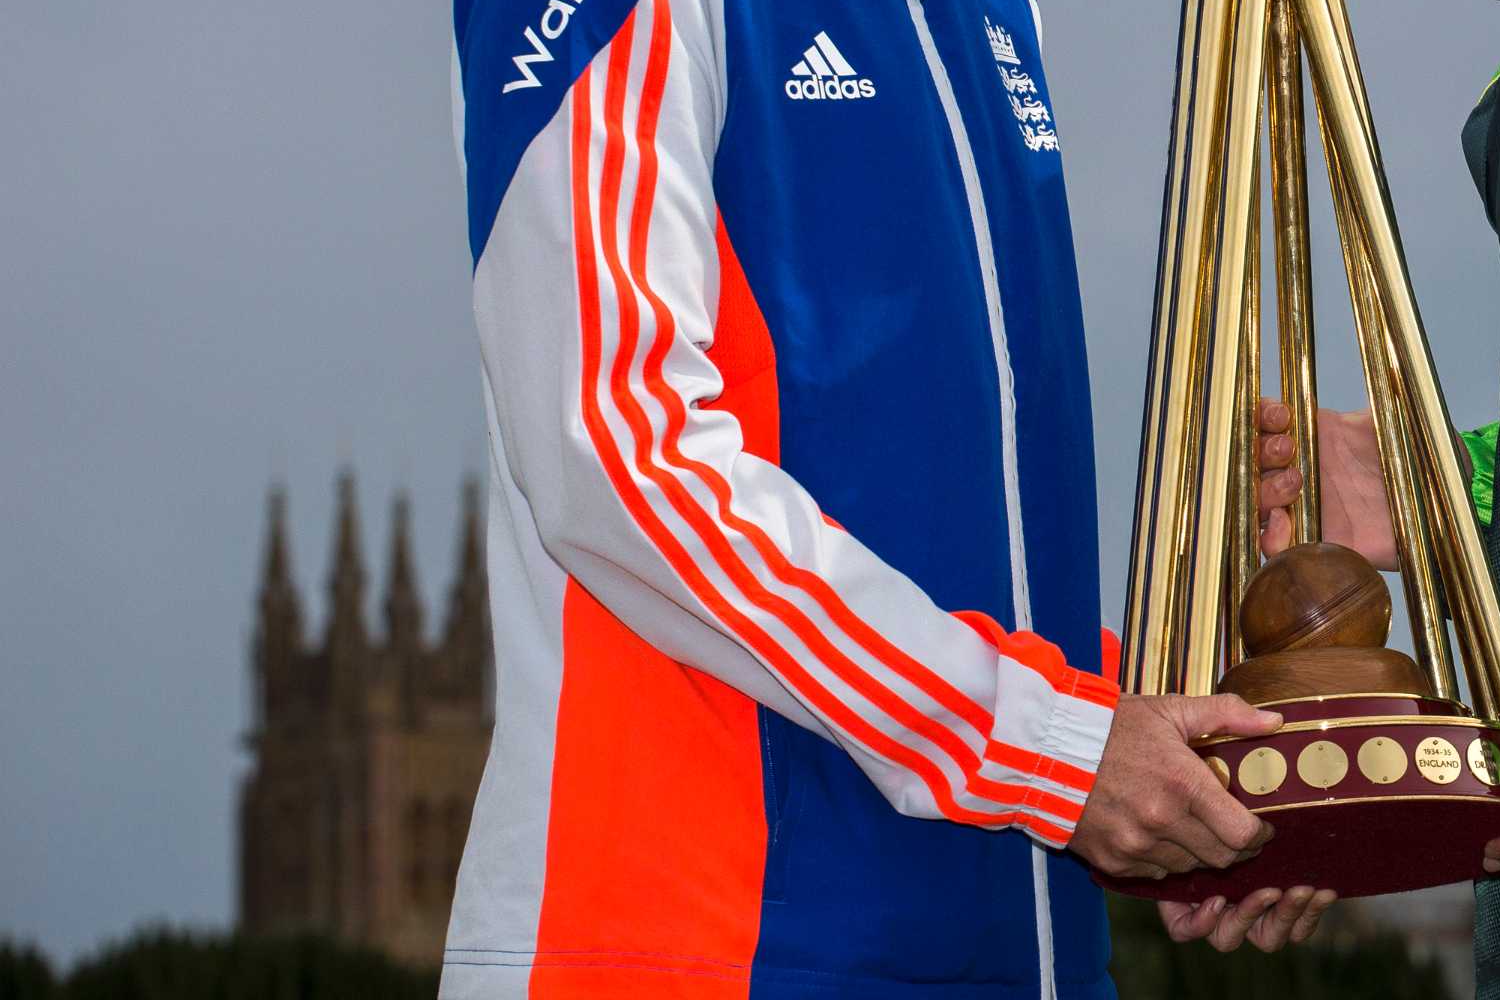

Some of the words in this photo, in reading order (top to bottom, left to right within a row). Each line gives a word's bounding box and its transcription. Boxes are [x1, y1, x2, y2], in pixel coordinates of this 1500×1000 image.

[785, 73, 876, 100] adidas
[1423, 747, 1452, 757] 1934-35
[1418, 758, 1459, 770] ENGLAND
